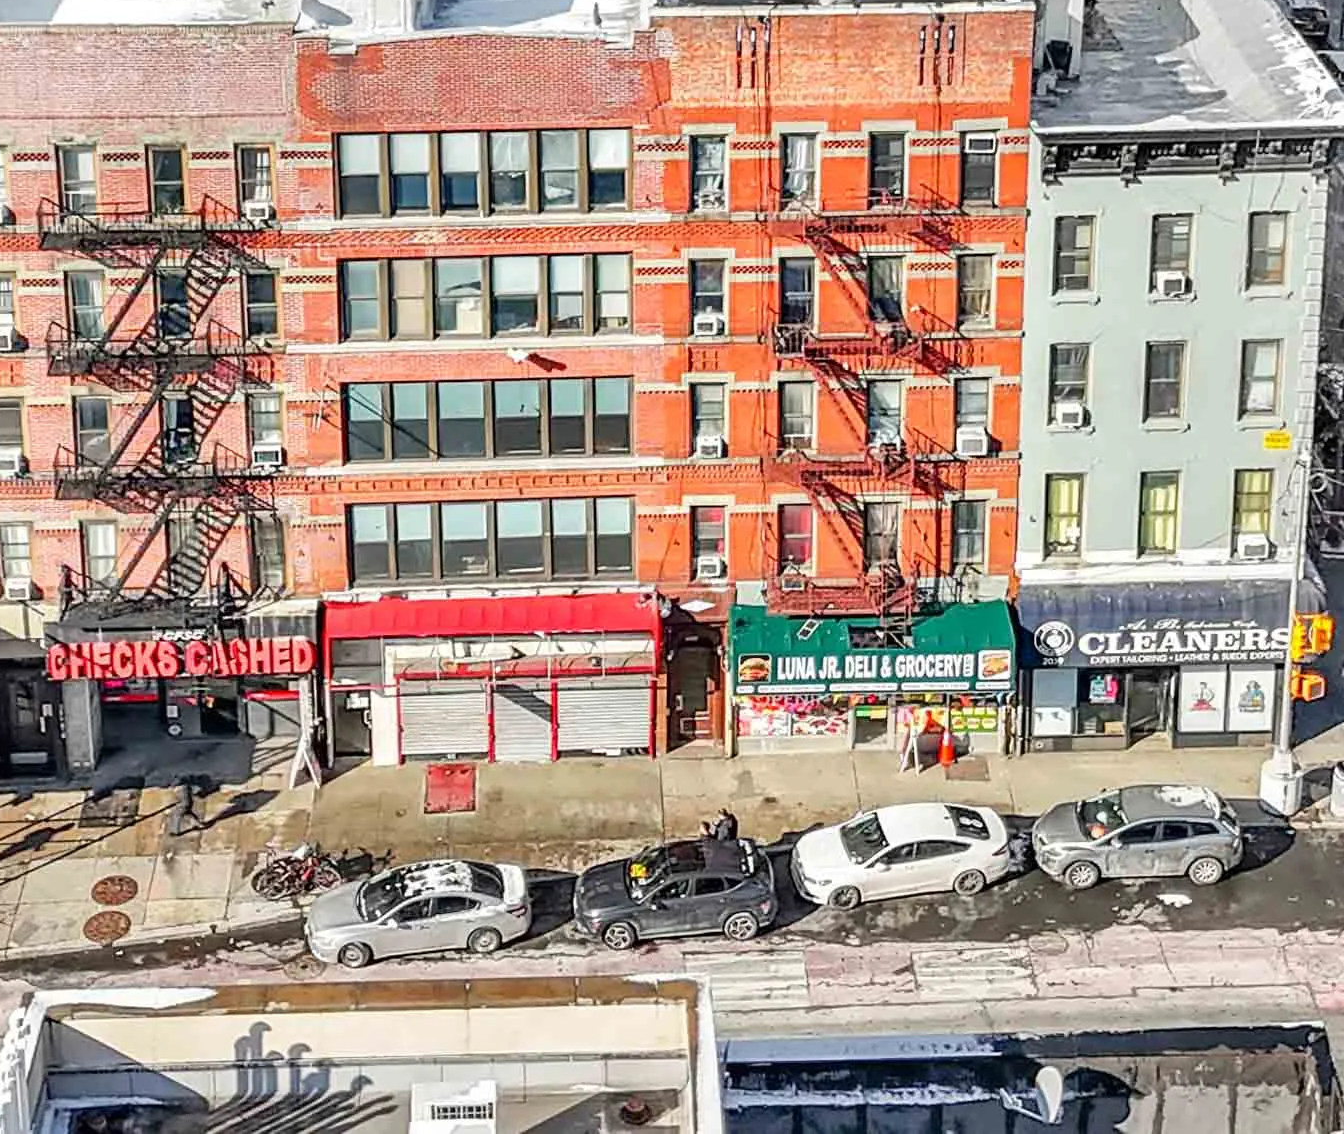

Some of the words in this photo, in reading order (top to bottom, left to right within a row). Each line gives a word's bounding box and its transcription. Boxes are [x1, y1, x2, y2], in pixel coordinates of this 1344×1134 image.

[1078, 628, 1290, 655] CLEANERS
[46, 640, 179, 681] CHECKS
[184, 635, 318, 678] CASHED
[777, 656, 816, 680] LUNA
[819, 656, 842, 680] JR.
[845, 655, 877, 678] DELI
[880, 654, 893, 678] &
[895, 654, 963, 678] GROCERY
[1090, 655, 1121, 665] EXPERT
[1122, 654, 1168, 664] TAILORING
[1174, 653, 1211, 662] LEATHER
[1221, 651, 1248, 661] SUEDE
[1249, 650, 1285, 661] EXPERTS
